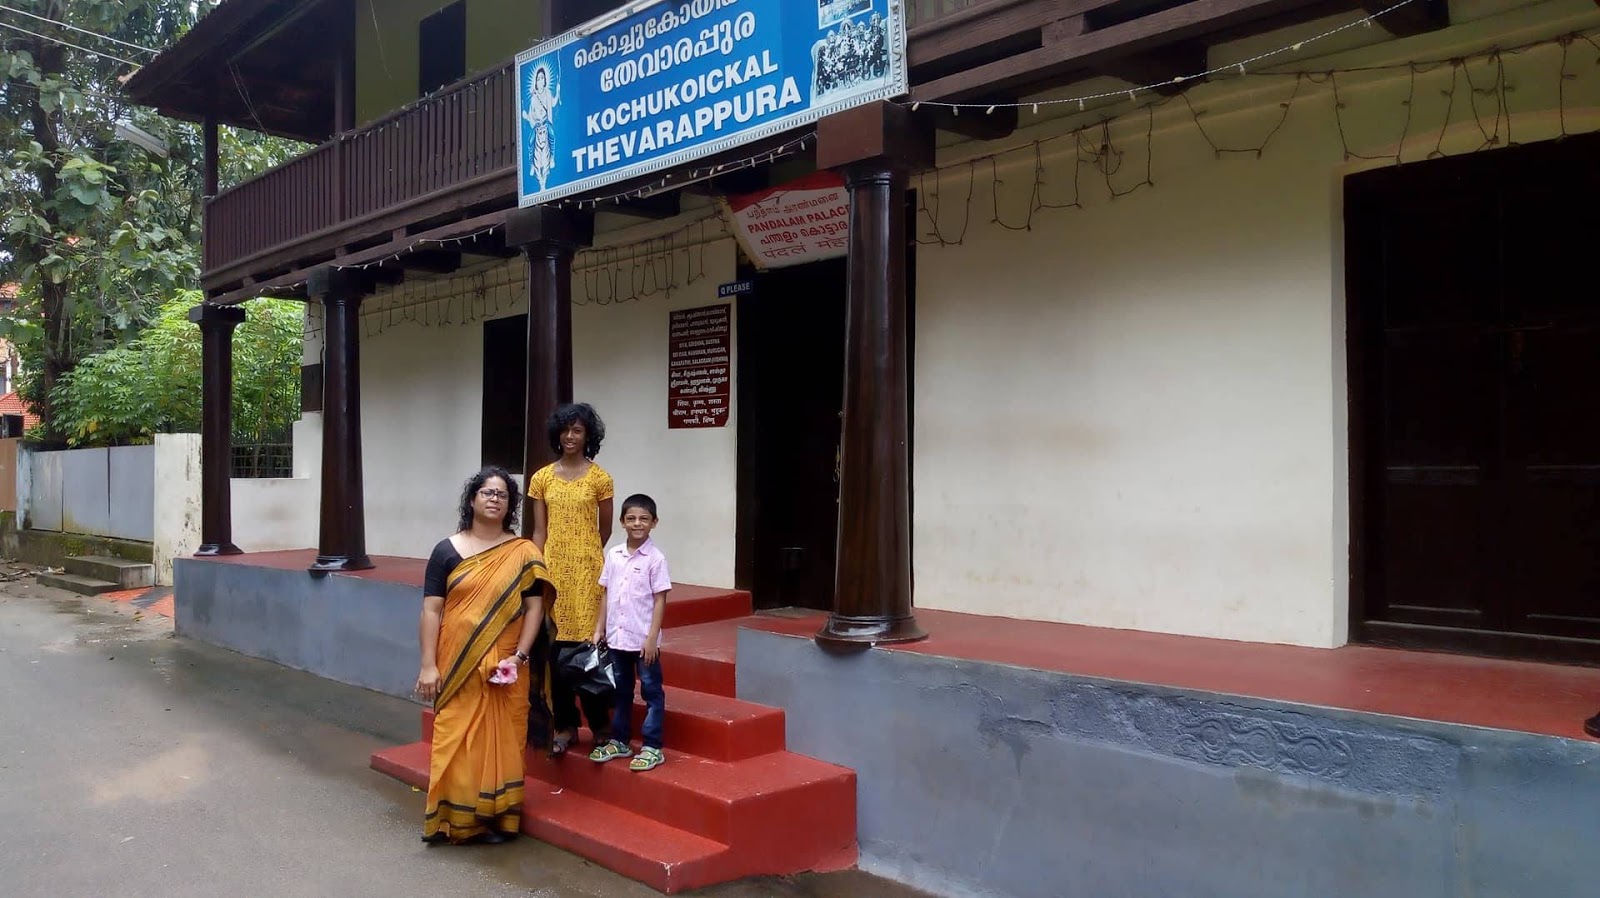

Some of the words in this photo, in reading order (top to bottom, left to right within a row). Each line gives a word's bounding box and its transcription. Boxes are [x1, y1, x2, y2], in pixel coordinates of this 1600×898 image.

[574, 0, 738, 69] കൊച്ചുകോയ
[600, 11, 756, 93] തേവാരപ്പുര
[571, 76, 801, 173] THEVARAPPURA
[586, 50, 778, 137] KOCHUKOICKAL
[748, 215, 806, 233] PANDALAM
[760, 231, 798, 246] പന്തളം
[720, 286, 726, 295] Q
[726, 282, 751, 294] PLEASE
